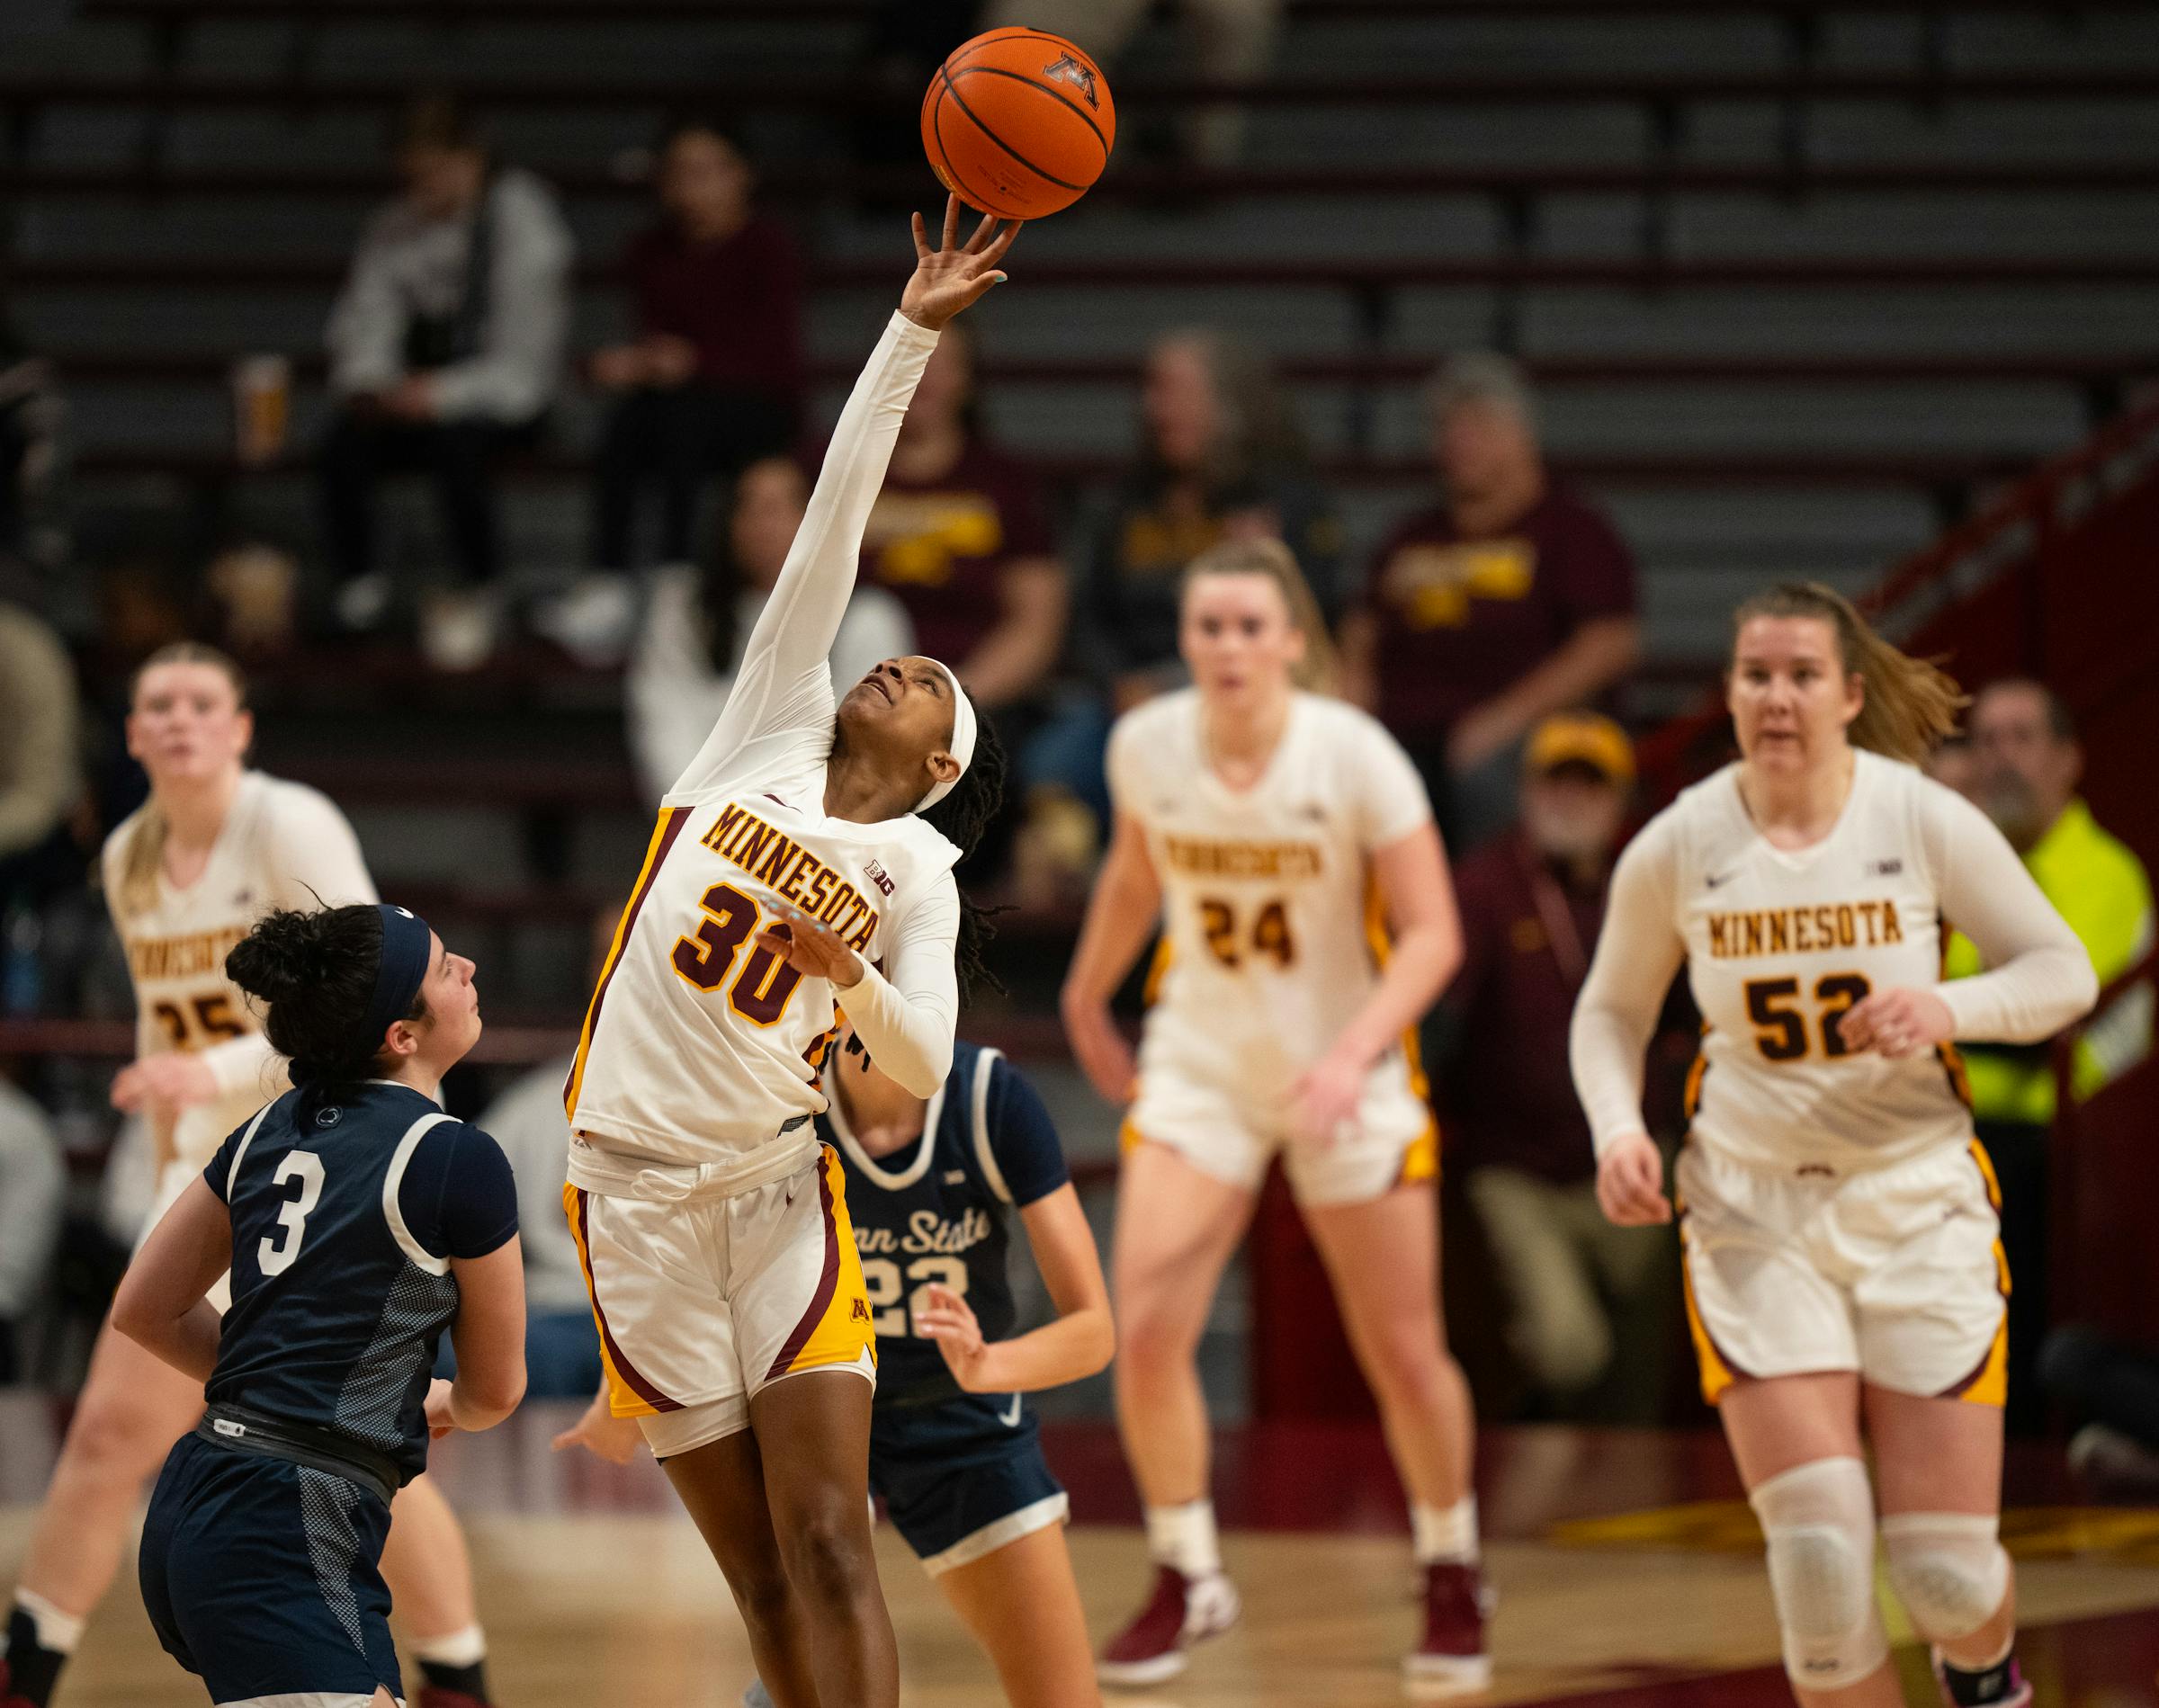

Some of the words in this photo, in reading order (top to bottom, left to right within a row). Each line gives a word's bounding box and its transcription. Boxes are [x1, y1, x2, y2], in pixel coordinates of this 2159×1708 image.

[700, 801, 880, 955] MINNESOTA
[669, 881, 805, 1029] 30
[1198, 898, 1296, 968] 24
[1708, 899, 1904, 959] MINNESOTA
[1743, 970, 1872, 1062] 52
[257, 1150, 326, 1276] 3
[854, 1226, 899, 1253] nn
